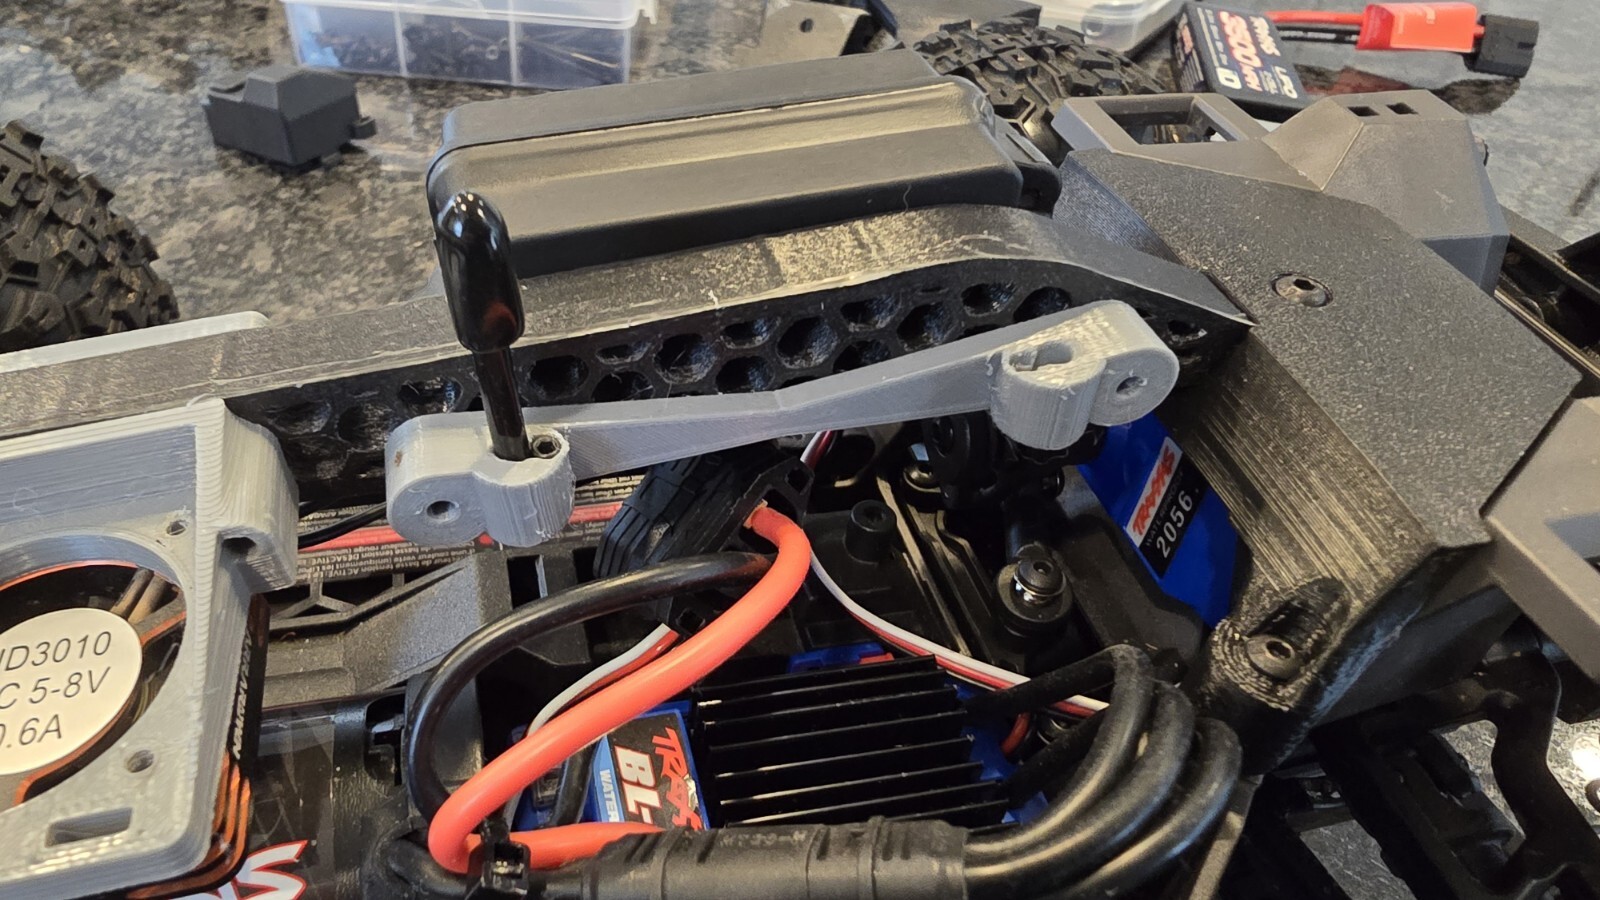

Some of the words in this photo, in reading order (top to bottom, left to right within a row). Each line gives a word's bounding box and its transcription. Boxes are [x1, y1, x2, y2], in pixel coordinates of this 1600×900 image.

[1132, 445, 1175, 536] TRAXXAS
[1156, 490, 1193, 558] 2056
[0, 631, 112, 672] D3010
[28, 666, 111, 704] 5-8V
